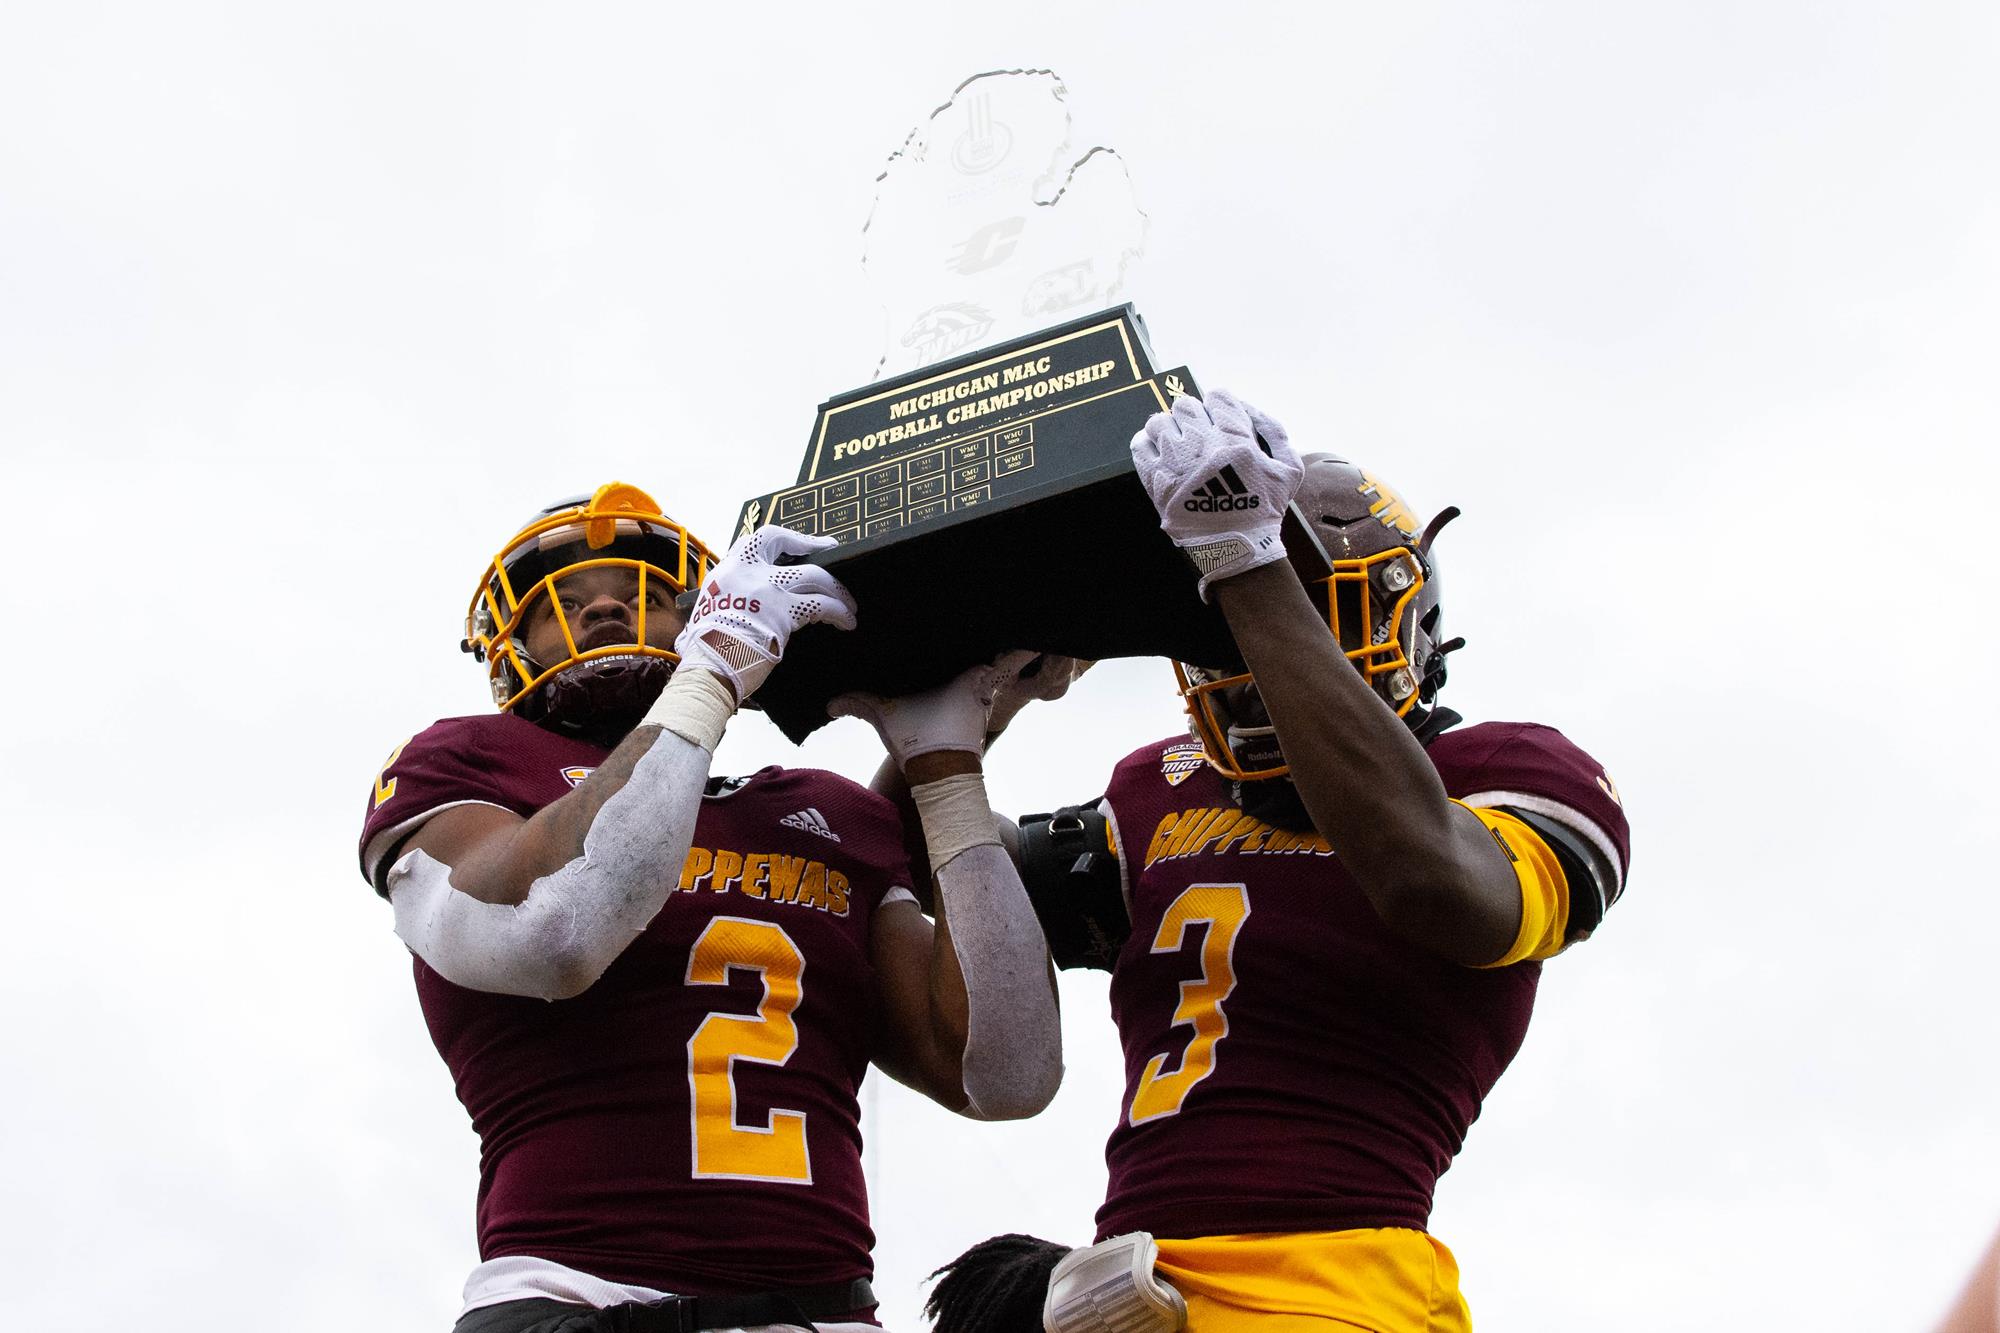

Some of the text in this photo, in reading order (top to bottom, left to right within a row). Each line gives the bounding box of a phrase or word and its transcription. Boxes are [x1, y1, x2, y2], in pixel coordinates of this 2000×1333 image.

[889, 357, 1051, 420] MICHIGAN MAC
[833, 413, 942, 461] FOOTBALL
[946, 360, 1116, 427] CHAMPIONSHIP
[1003, 429, 1023, 440] WMU
[959, 443, 979, 454] WMU
[1004, 453, 1024, 463] WMU
[961, 467, 979, 477] CMU
[960, 491, 980, 502] WMU
[1184, 493, 1260, 513] adidas
[692, 593, 761, 624] adidas
[583, 654, 634, 669] Riddell
[1160, 759, 1204, 773] MAC
[780, 817, 842, 843] adidas
[675, 846, 851, 917] PPEWAS
[1129, 883, 1251, 1127] 3
[684, 915, 814, 1186] 2
